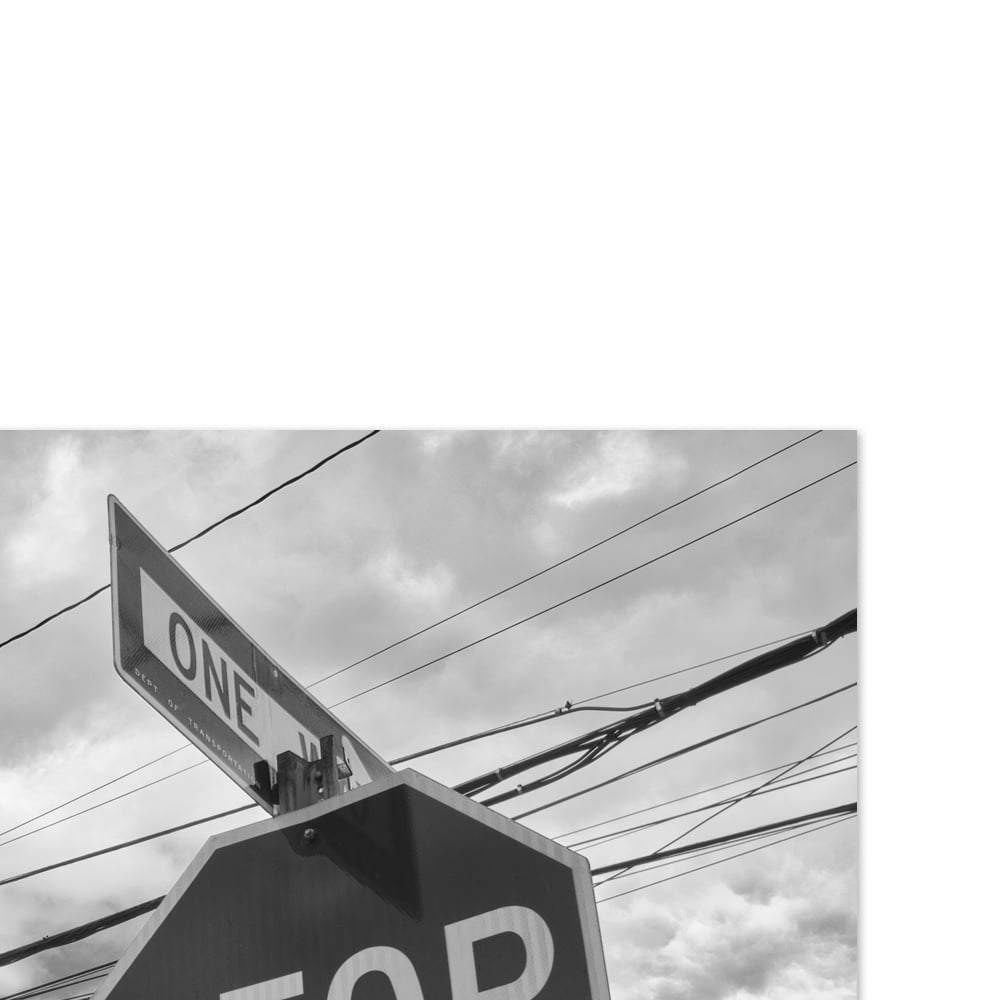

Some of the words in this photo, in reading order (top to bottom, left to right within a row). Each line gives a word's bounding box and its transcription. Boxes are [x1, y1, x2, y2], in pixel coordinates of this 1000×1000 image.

[134, 668, 158, 693] DEPT
[167, 698, 179, 711] OF
[168, 611, 260, 747] ONE
